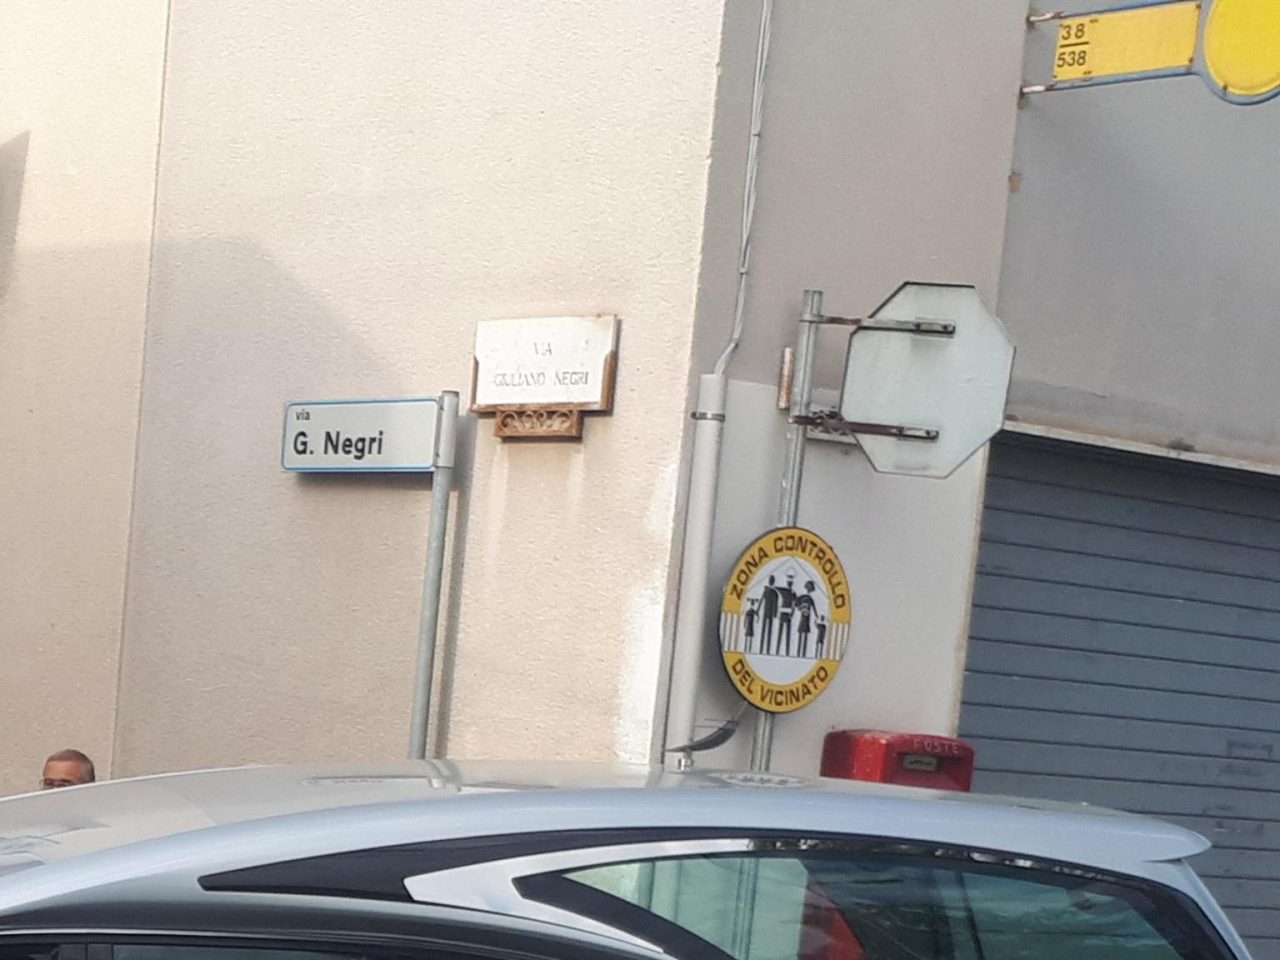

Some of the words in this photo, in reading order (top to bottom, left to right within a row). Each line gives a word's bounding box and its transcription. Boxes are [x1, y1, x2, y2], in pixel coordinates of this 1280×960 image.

[1061, 22, 1085, 41] 38
[1056, 50, 1087, 68] 538
[553, 371, 589, 386] NEGRI
[295, 408, 310, 421] via
[293, 431, 314, 455] G.
[324, 430, 383, 460] Negri
[730, 546, 769, 600] ZONA
[773, 535, 845, 609] CONTROLLO
[732, 659, 755, 695] DEL
[760, 666, 829, 706] VICINATO
